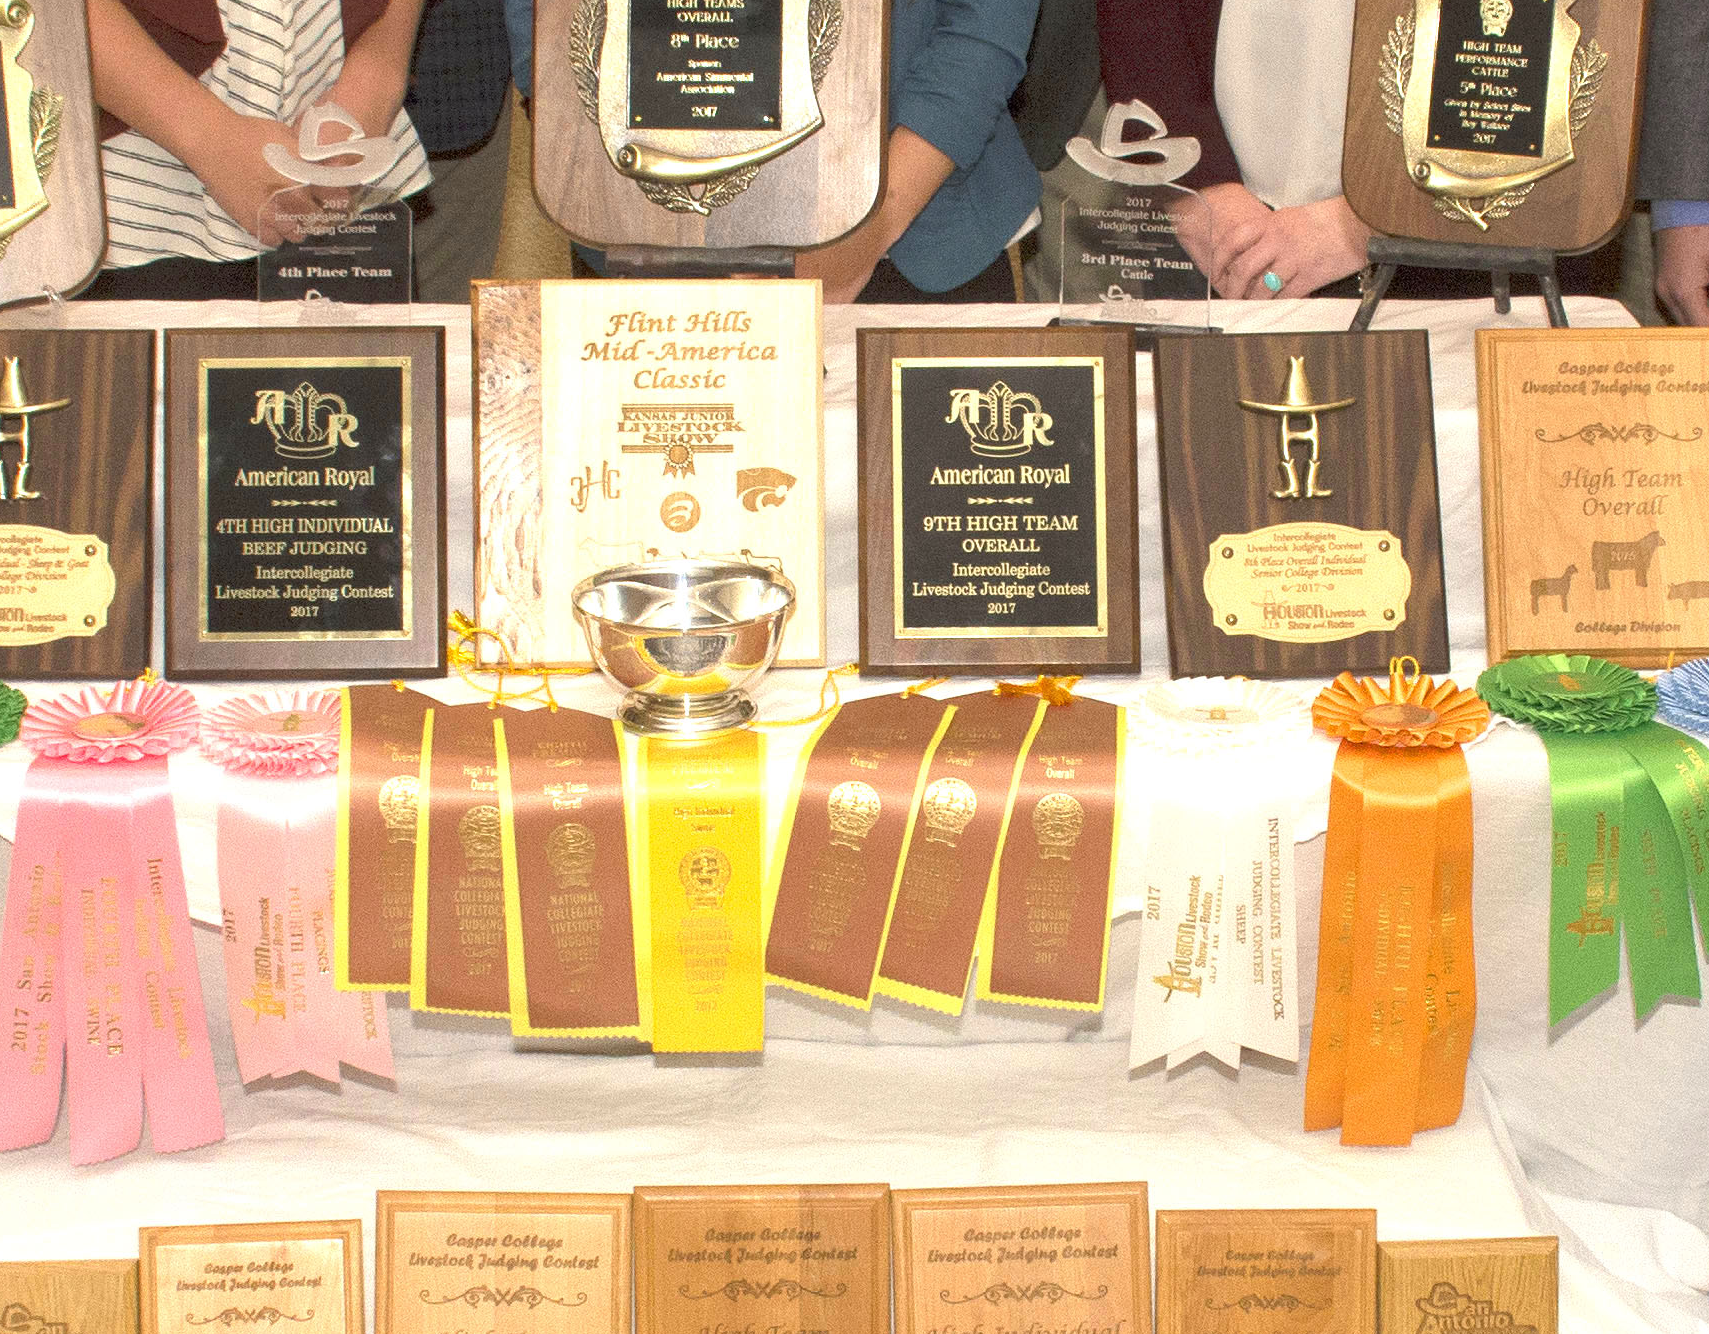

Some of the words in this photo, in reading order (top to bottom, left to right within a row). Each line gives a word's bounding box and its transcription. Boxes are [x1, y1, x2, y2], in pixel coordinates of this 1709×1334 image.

[677, 12, 733, 23] OVERALL
[670, 34, 690, 48] 8th
[695, 33, 739, 48] Place
[1463, 41, 1490, 53] HIGH
[1494, 44, 1522, 55] TEAM
[1455, 54, 1528, 68] PERFORMANCE
[1471, 66, 1509, 78] CATTLE
[1479, 81, 1518, 98] Place
[691, 106, 717, 117] 2017
[1473, 133, 1496, 144] 2017
[1082, 254, 1106, 265] 3rd
[1110, 255, 1150, 267] Place
[1154, 258, 1193, 270] Team
[278, 266, 302, 278] 4th
[307, 267, 348, 277] Place
[352, 267, 392, 277] Team
[1121, 270, 1154, 280] Cattle
[605, 311, 677, 337] Flint
[685, 311, 752, 334] Hills
[633, 369, 726, 390] Classic
[623, 412, 677, 421] KANSAS
[681, 412, 735, 421] JUNIOR
[617, 421, 745, 432] LIVESTOCK
[642, 433, 721, 444] SHOW
[235, 468, 319, 487] American
[325, 467, 375, 490] Royal
[931, 466, 1015, 486] American
[1021, 465, 1070, 488] Royal
[1559, 467, 1616, 495] High
[1623, 469, 1683, 488] Team
[1582, 497, 1666, 516] Overall
[216, 518, 247, 534] 4TH
[251, 518, 293, 534] HIGH
[297, 518, 393, 533] INDIVIDUAL
[924, 516, 962, 531] 9TH
[966, 516, 1018, 531] HIGH
[1024, 516, 1079, 531] TEAM
[242, 542, 284, 556] BEEF
[289, 542, 367, 556] JUDGING
[962, 539, 1040, 553] OVERALL
[255, 567, 354, 581] Intercollegiate
[953, 564, 1050, 578] Intercollegiate
[215, 586, 280, 599] Livestock
[283, 586, 337, 601] Judging
[341, 586, 393, 599] Contest
[912, 583, 977, 596] Livestock
[980, 583, 1034, 598] Judging
[1038, 582, 1090, 596] Contest
[290, 606, 319, 617] 2017
[988, 603, 1016, 614] 2017
[1147, 885, 1162, 921] 2017
[1253, 924, 1264, 986] CONTEST
[1270, 946, 1285, 1020] LIVESTOCK
